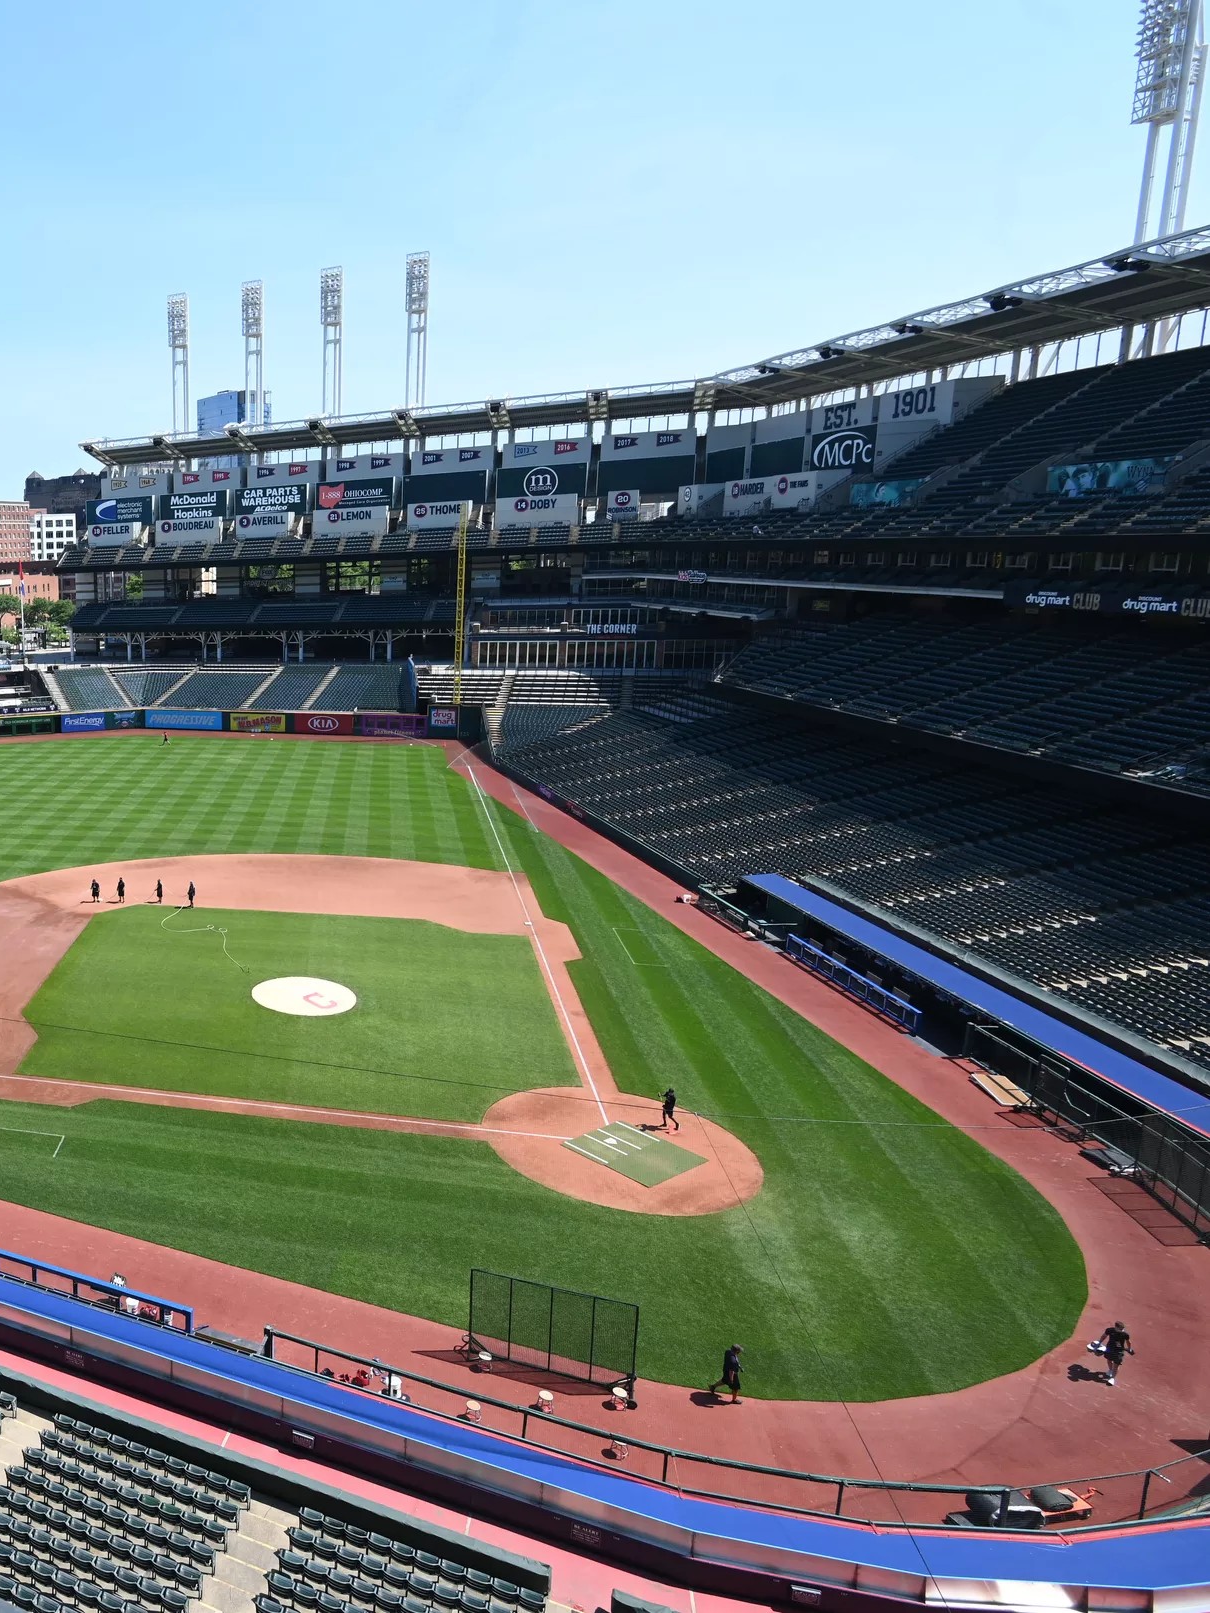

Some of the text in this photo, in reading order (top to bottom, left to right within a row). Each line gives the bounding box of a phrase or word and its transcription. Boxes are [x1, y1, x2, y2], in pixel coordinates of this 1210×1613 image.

[892, 387, 936, 419] 1901
[823, 402, 858, 431] EST.
[244, 486, 298, 498] CAR PARTS
[740, 482, 764, 496] HARDER
[170, 492, 217, 506] McDonald
[241, 495, 301, 507] WAREHOUSE
[322, 491, 341, 500] 1-888
[429, 504, 461, 515] THOME
[530, 498, 558, 510] DOBY
[607, 506, 637, 514] ROBINSON
[174, 508, 213, 520] Hopkins
[341, 510, 372, 521] LEMON
[172, 520, 214, 531] BOUDREAU
[252, 516, 286, 526] AVERILL
[102, 526, 130, 536] FELLER
[1026, 592, 1100, 610] drug mart CLUB
[1122, 598, 1146, 614] drug
[1148, 600, 1178, 612] mart
[586, 624, 636, 634] THE CORNER
[149, 714, 217, 726] PROGRESSIVE
[433, 708, 452, 720] drug
[64, 716, 104, 726] FirstEnergy
[313, 719, 334, 728] KIA
